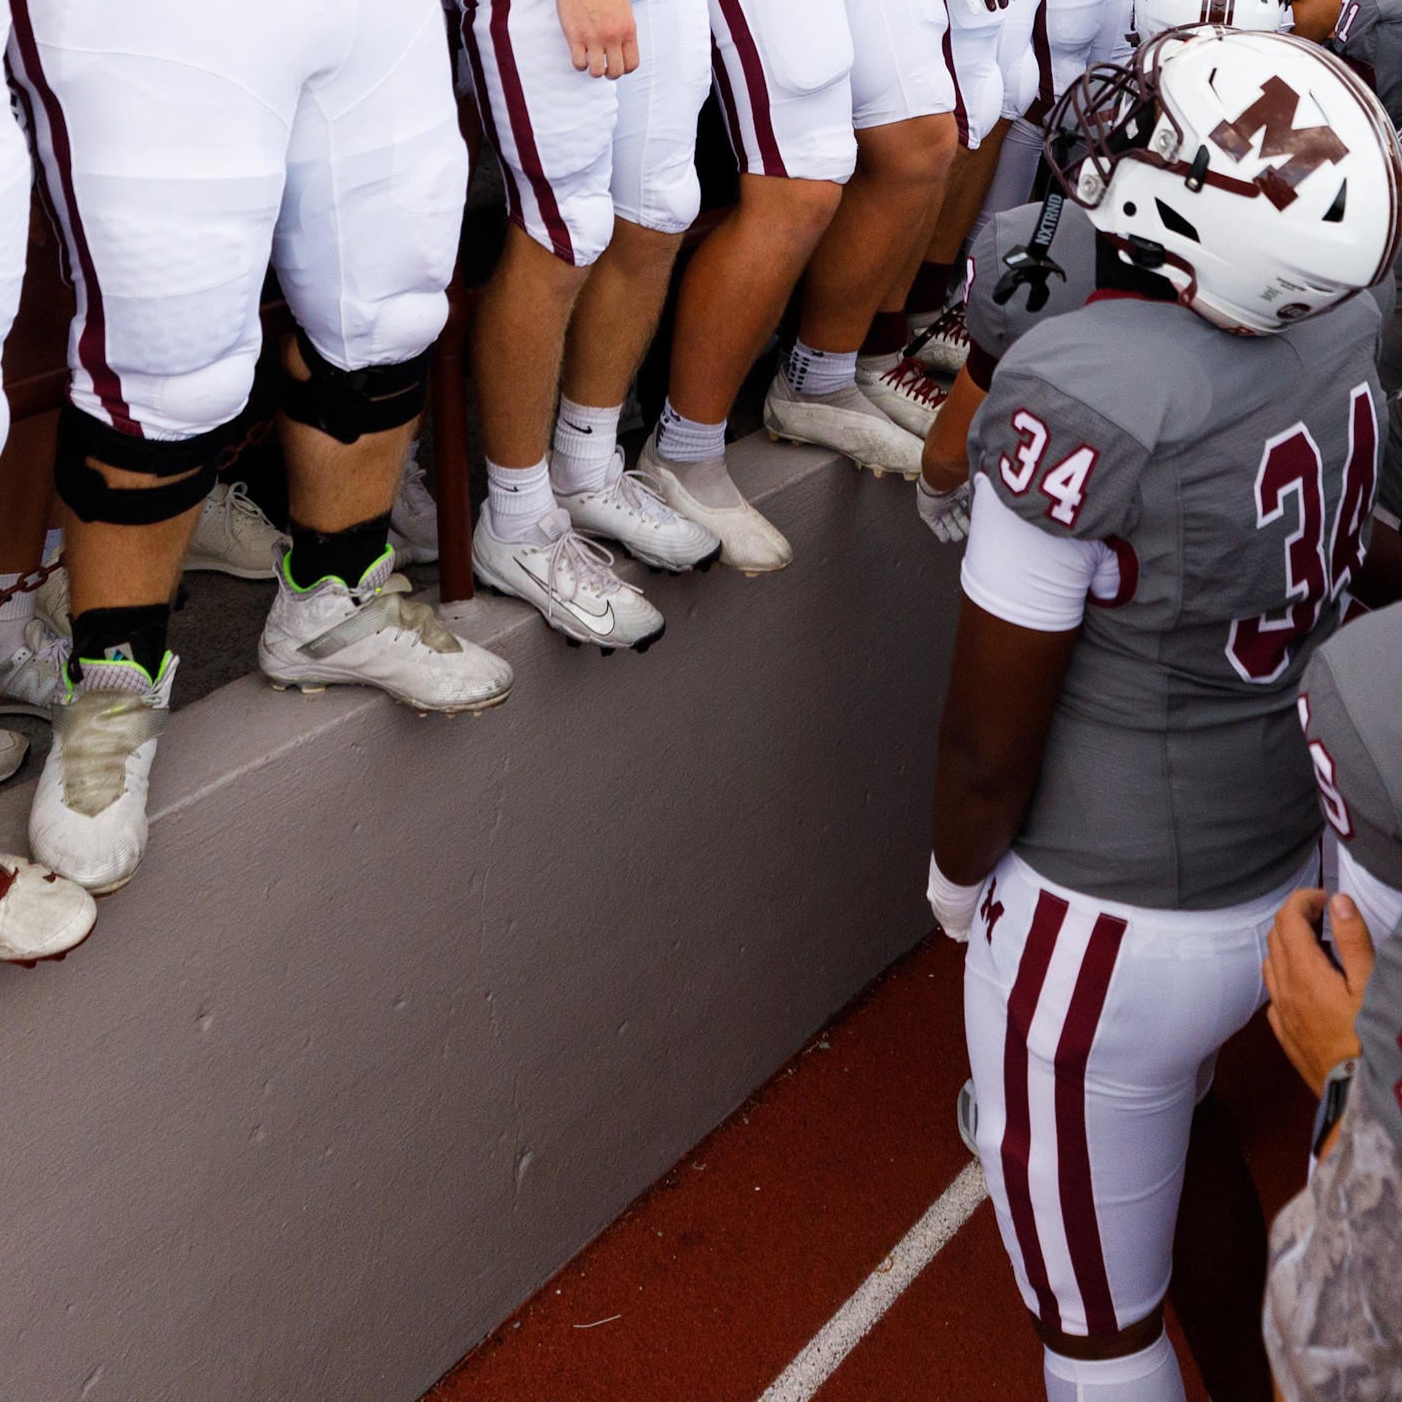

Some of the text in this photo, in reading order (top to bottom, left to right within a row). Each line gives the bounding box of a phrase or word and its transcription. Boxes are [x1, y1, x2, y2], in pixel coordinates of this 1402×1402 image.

[1208, 75, 1350, 212] M
[1034, 193, 1064, 246] NXTRND
[999, 408, 1099, 529] 34
[1224, 381, 1379, 683] 34
